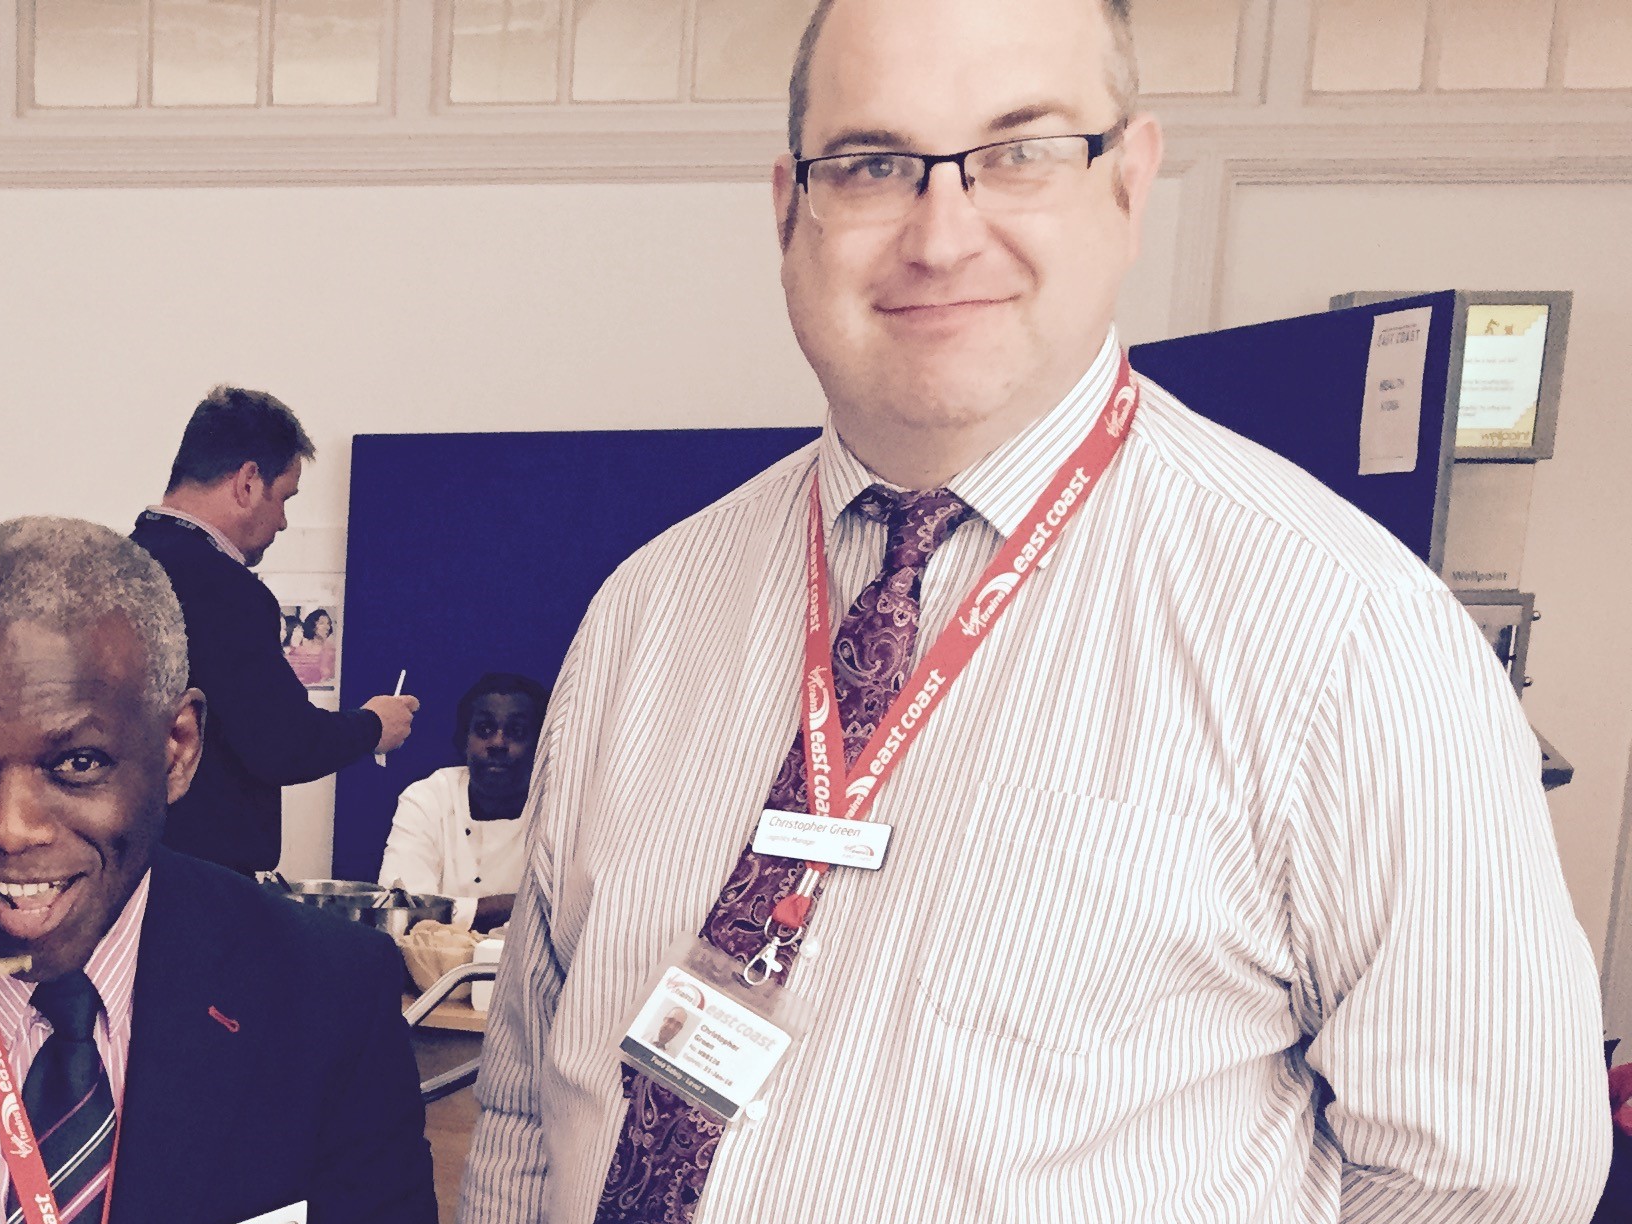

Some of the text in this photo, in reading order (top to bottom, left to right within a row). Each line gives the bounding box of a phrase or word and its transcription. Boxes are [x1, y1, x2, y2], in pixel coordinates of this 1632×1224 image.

[1013, 467, 1090, 574] east coast
[981, 590, 1006, 629] trains
[870, 668, 947, 775] east coast
[810, 731, 831, 773] east
[769, 816, 861, 837] Christopher Green
[694, 1034, 715, 1050] Green
[699, 1024, 740, 1052] Christopher
[705, 1002, 776, 1052] east coast
